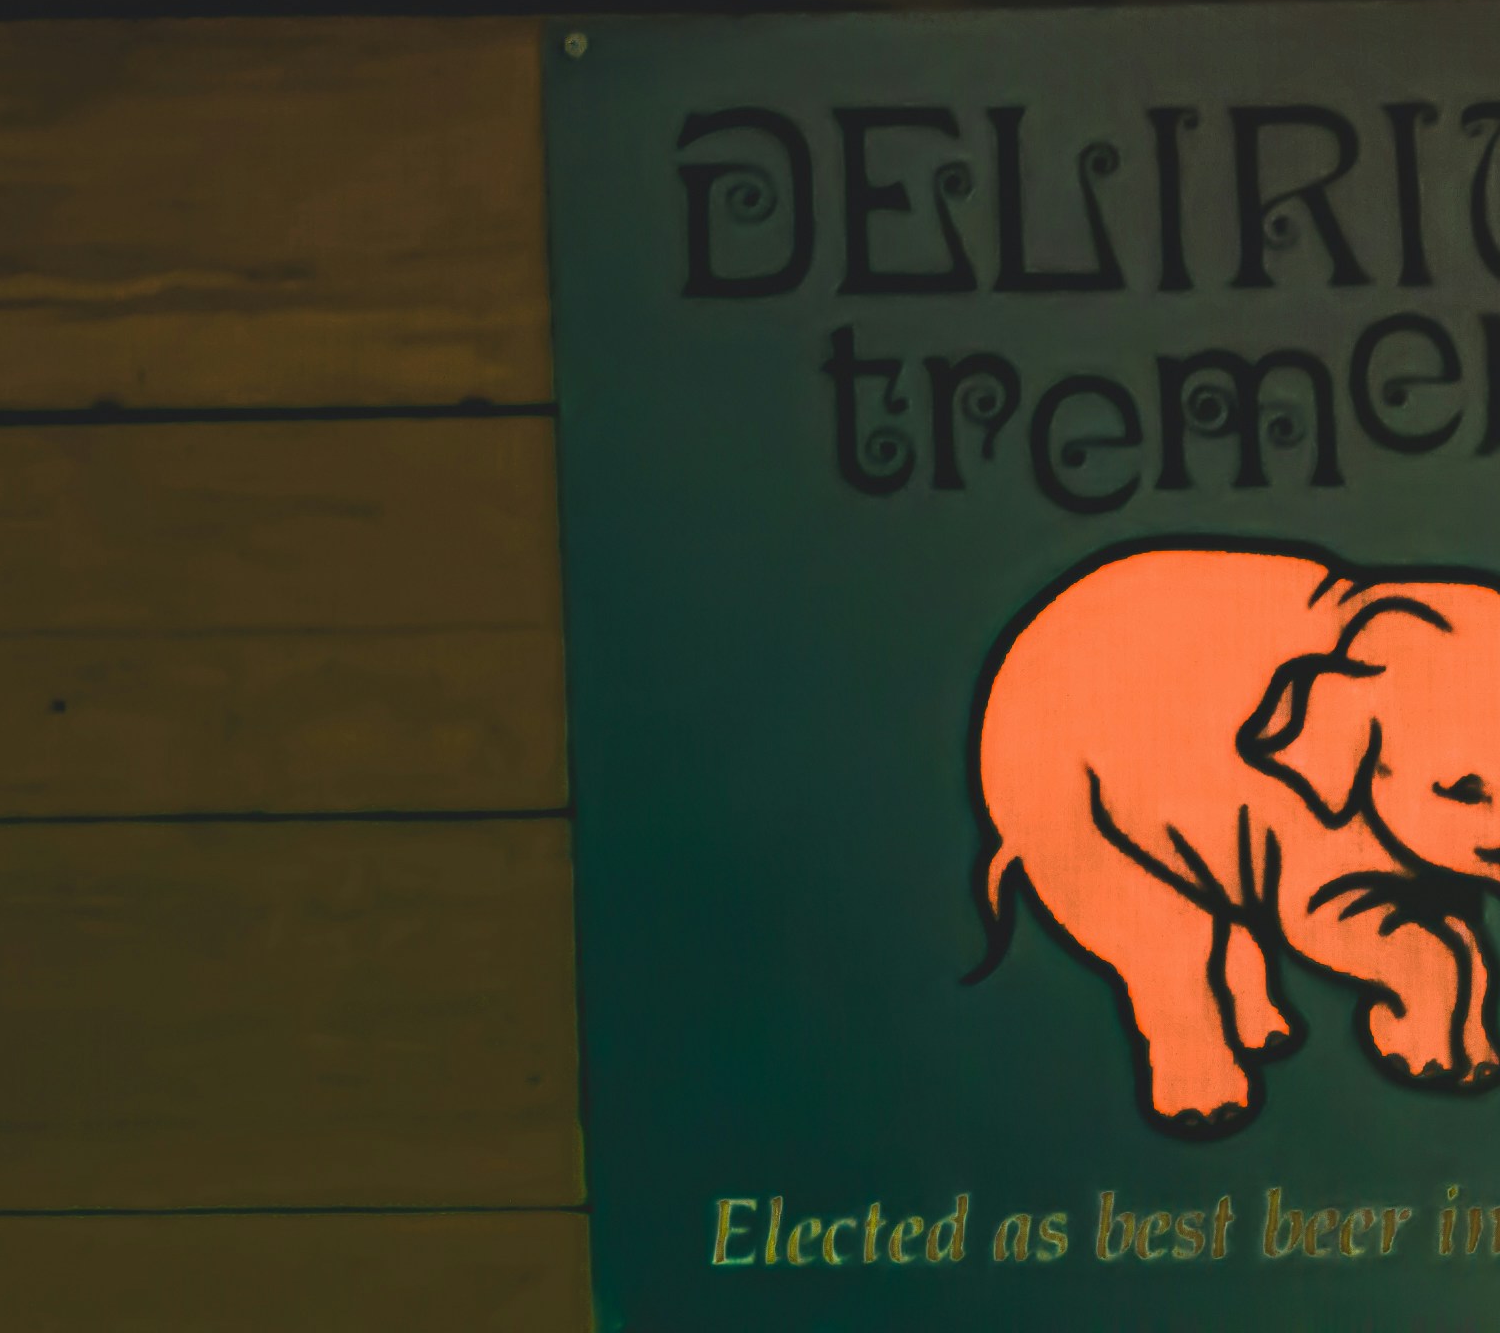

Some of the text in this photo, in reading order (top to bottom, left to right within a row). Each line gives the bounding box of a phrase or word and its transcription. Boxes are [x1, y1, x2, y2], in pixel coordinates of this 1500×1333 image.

[711, 1192, 971, 1266] Elected
[993, 1212, 1070, 1263] as
[1095, 1189, 1236, 1262] best
[1261, 1185, 1414, 1260] beer
